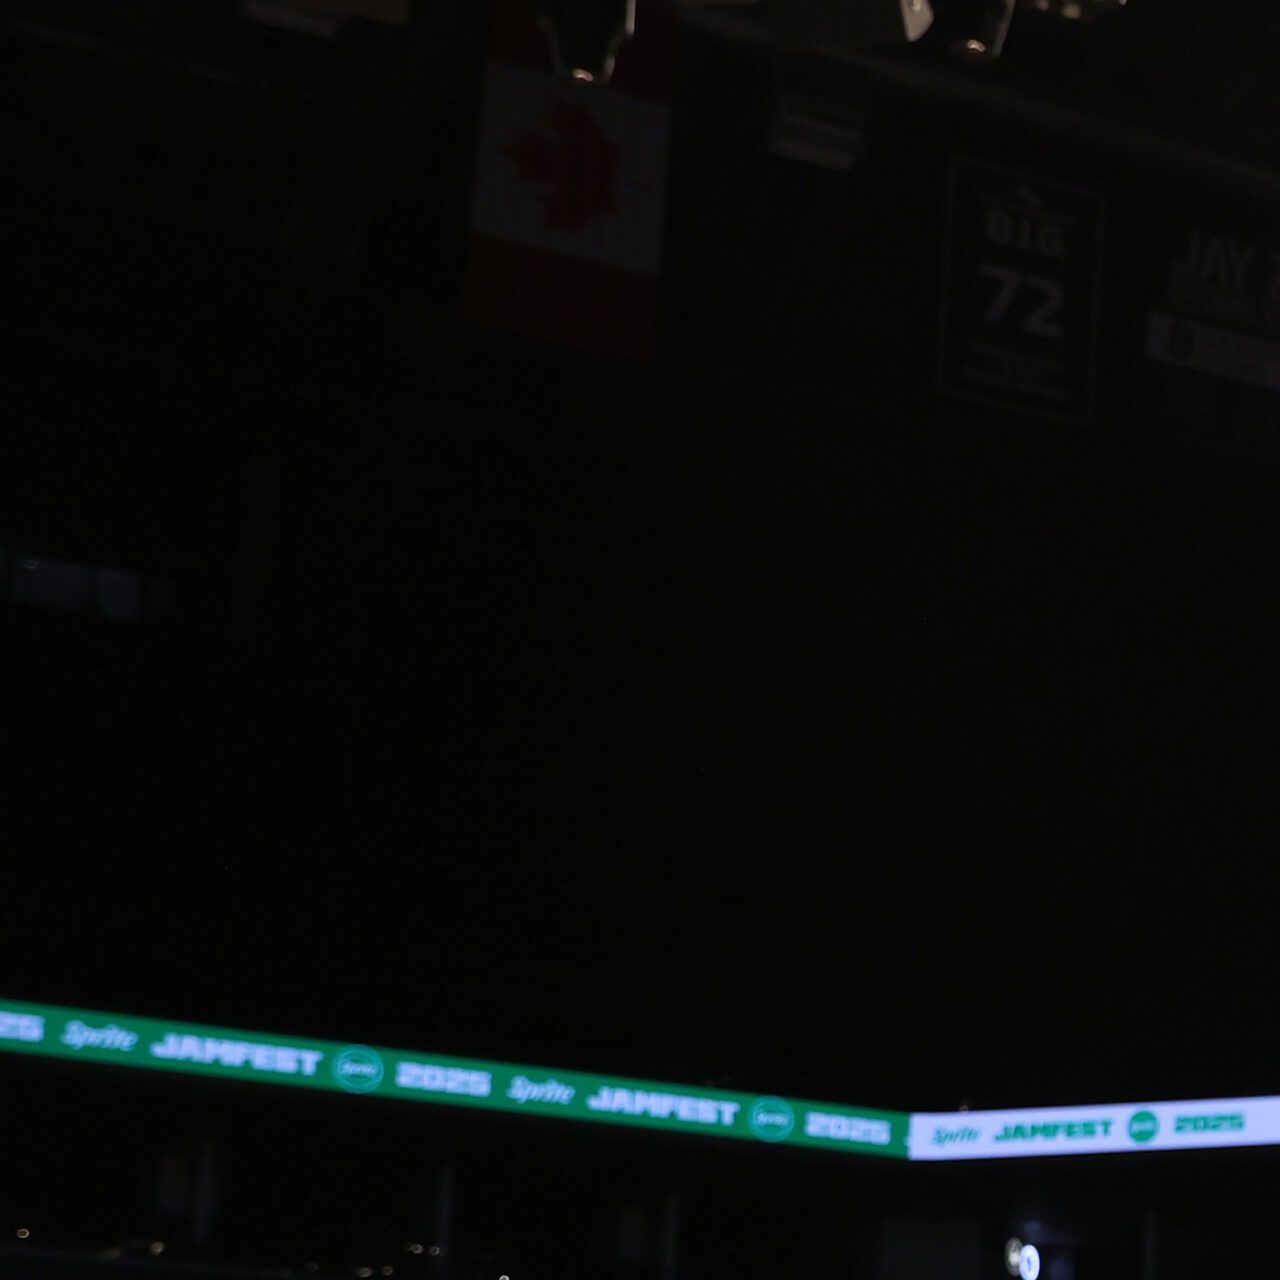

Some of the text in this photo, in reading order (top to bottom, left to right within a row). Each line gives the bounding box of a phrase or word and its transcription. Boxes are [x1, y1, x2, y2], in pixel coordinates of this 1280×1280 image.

[61, 1019, 138, 1050] Sprite
[150, 1031, 322, 1076] JAMFEST
[395, 1061, 741, 1127] 2025 Sprite JAMFEST
[804, 1111, 892, 1146] 2025
[993, 1117, 1113, 1143] JAMFEST
[1174, 1112, 1246, 1134] 2025
